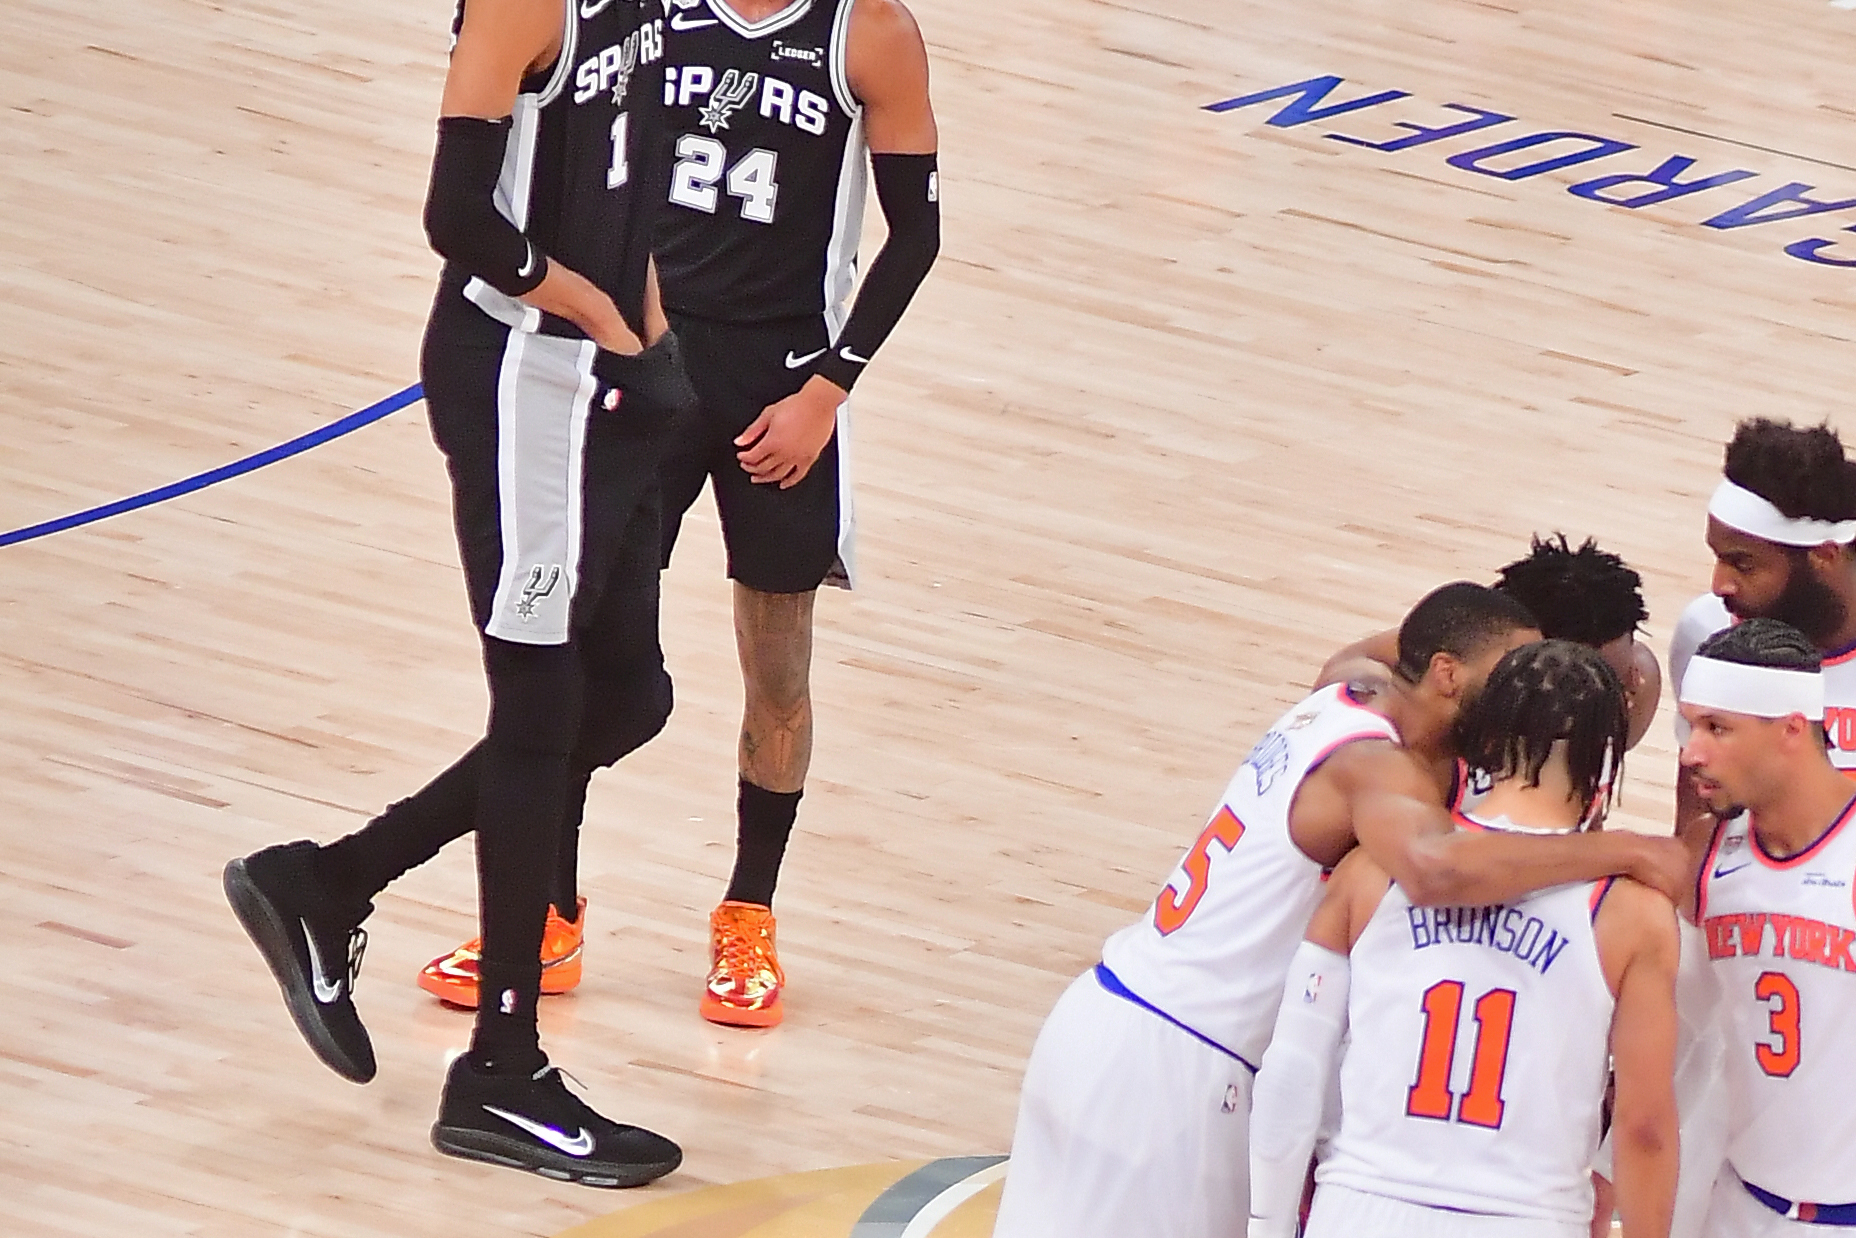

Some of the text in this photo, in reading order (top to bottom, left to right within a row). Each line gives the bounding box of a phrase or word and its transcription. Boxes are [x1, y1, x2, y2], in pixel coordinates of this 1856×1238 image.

[606, 111, 629, 189] 1
[668, 133, 778, 223] 24
[1407, 903, 1568, 975] BRUNSON
[1405, 978, 1517, 1131] 11
[1755, 970, 1801, 1078] 3
